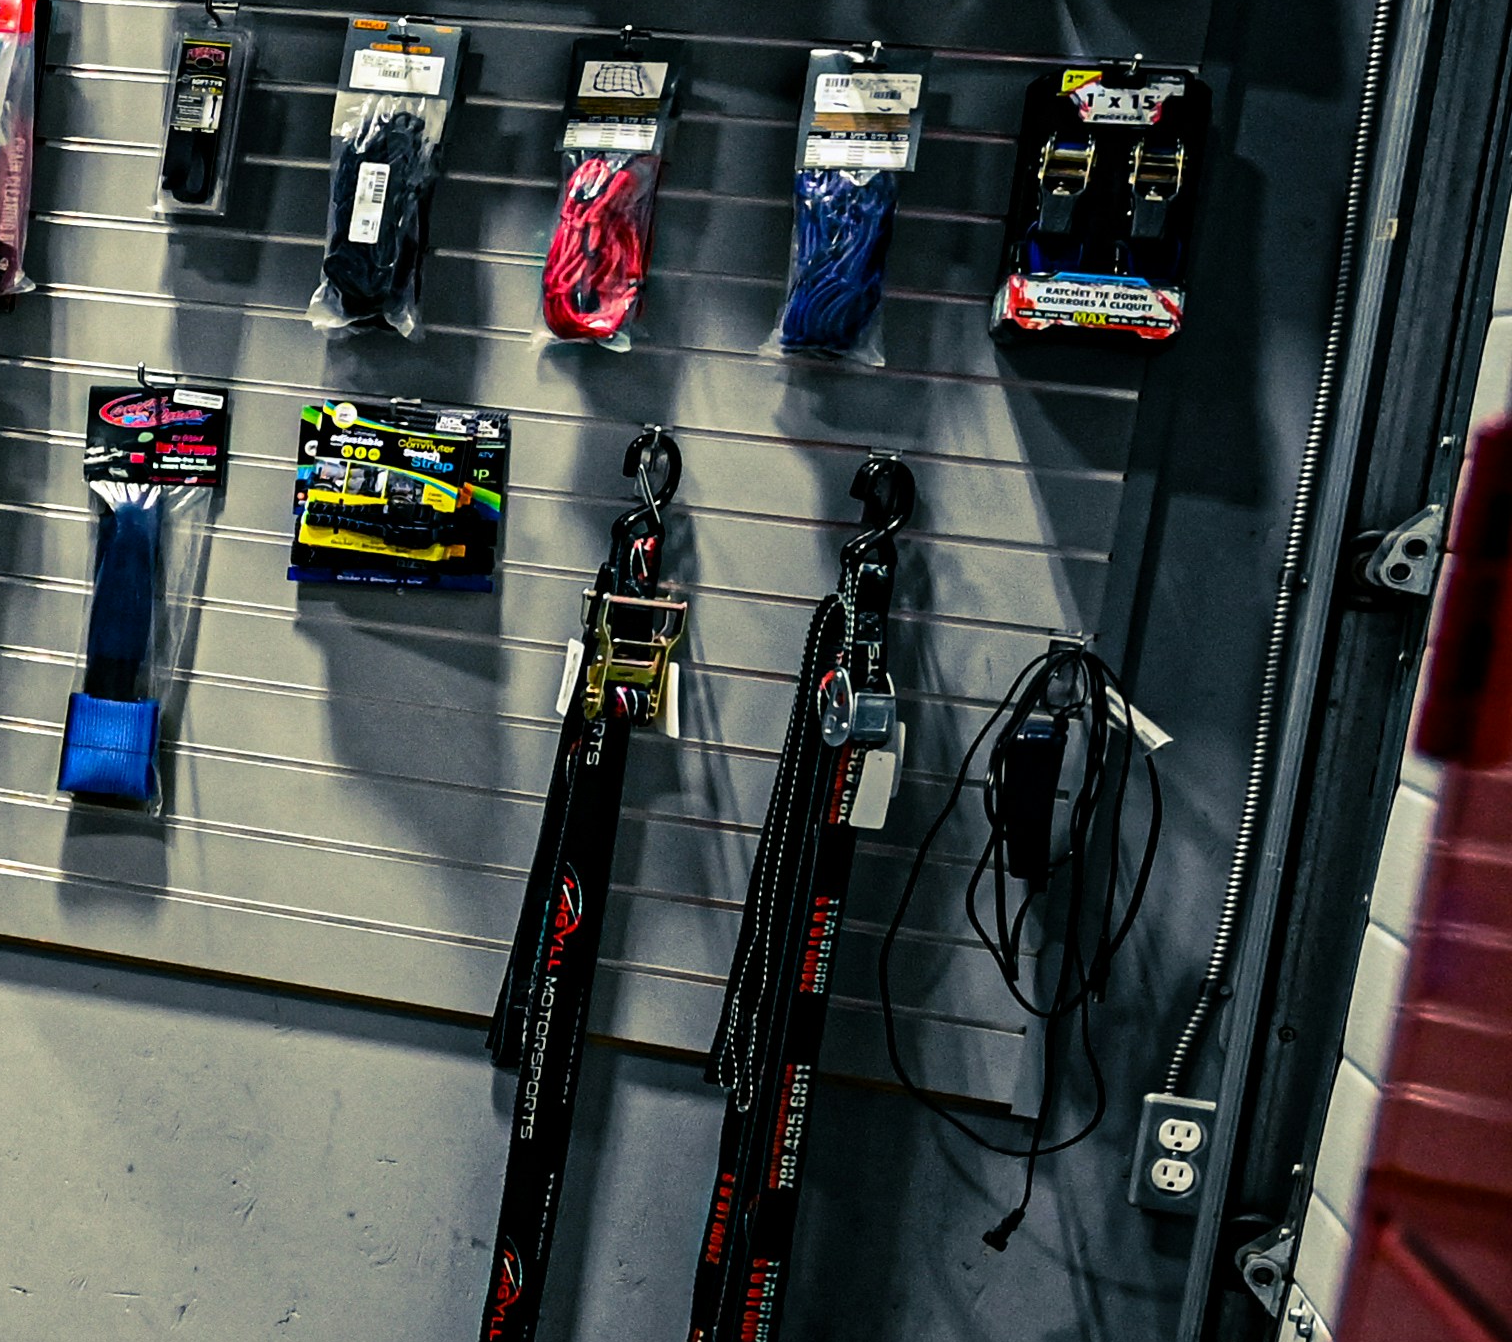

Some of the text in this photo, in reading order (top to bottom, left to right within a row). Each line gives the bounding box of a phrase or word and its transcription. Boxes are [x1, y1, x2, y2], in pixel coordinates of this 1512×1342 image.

[1046, 287, 1148, 301] RATCHET TIE DOWN
[1037, 296, 1096, 307] COURROIES
[1110, 302, 1153, 311] CLIQUET
[1073, 311, 1107, 325] MAX
[330, 435, 383, 447] adjustable
[398, 438, 455, 454] Commuter
[411, 457, 454, 473] Strap
[547, 875, 581, 970] ARGYLL
[520, 975, 558, 1140] MOTORSPORTS
[778, 1064, 811, 1189] 780.435.6811
[489, 1249, 515, 1341] ARGYLL
